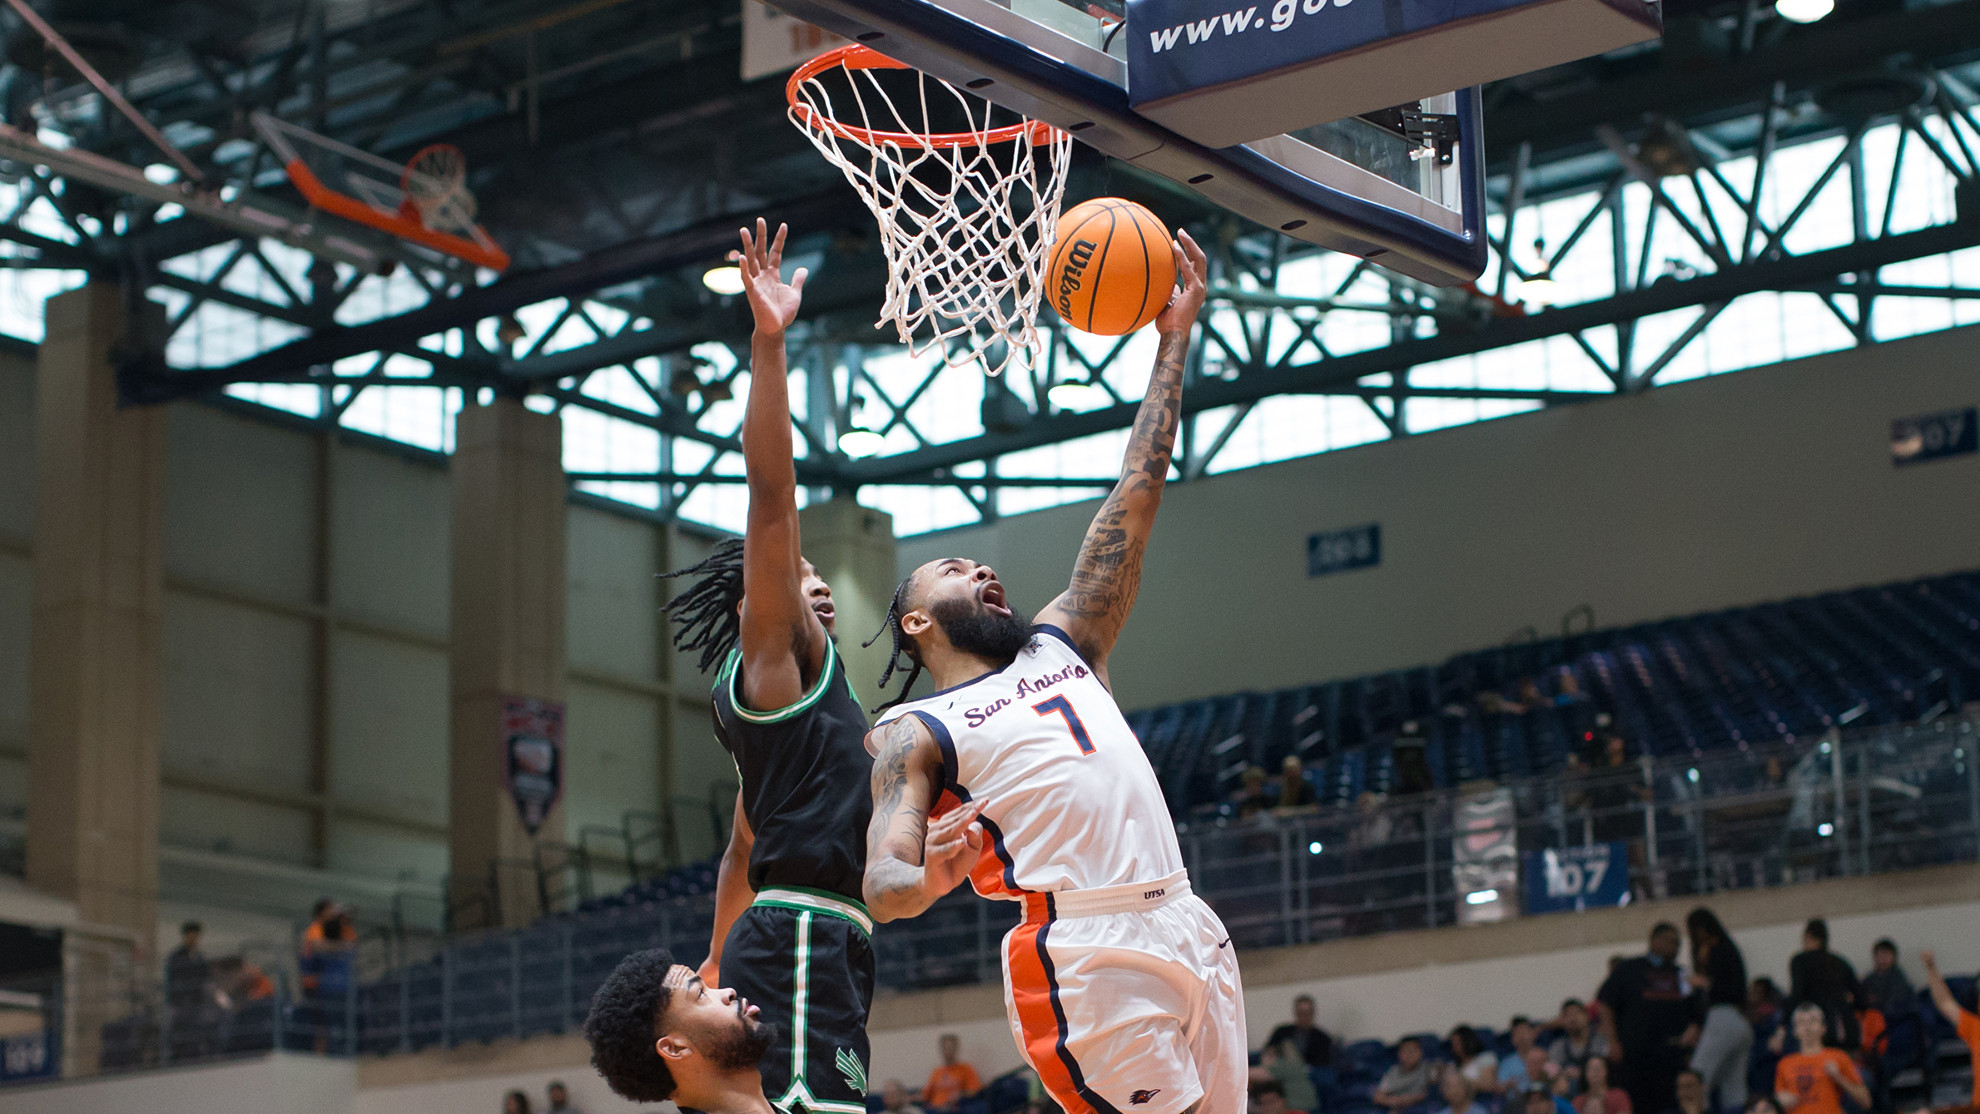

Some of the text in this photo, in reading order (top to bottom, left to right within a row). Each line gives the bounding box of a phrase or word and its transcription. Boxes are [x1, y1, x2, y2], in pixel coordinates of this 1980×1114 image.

[1059, 239, 1098, 321] Wilson
[964, 665, 1089, 728] San Antonio
[1031, 693, 1096, 756] 7
[1144, 888, 1165, 900] UTSA
